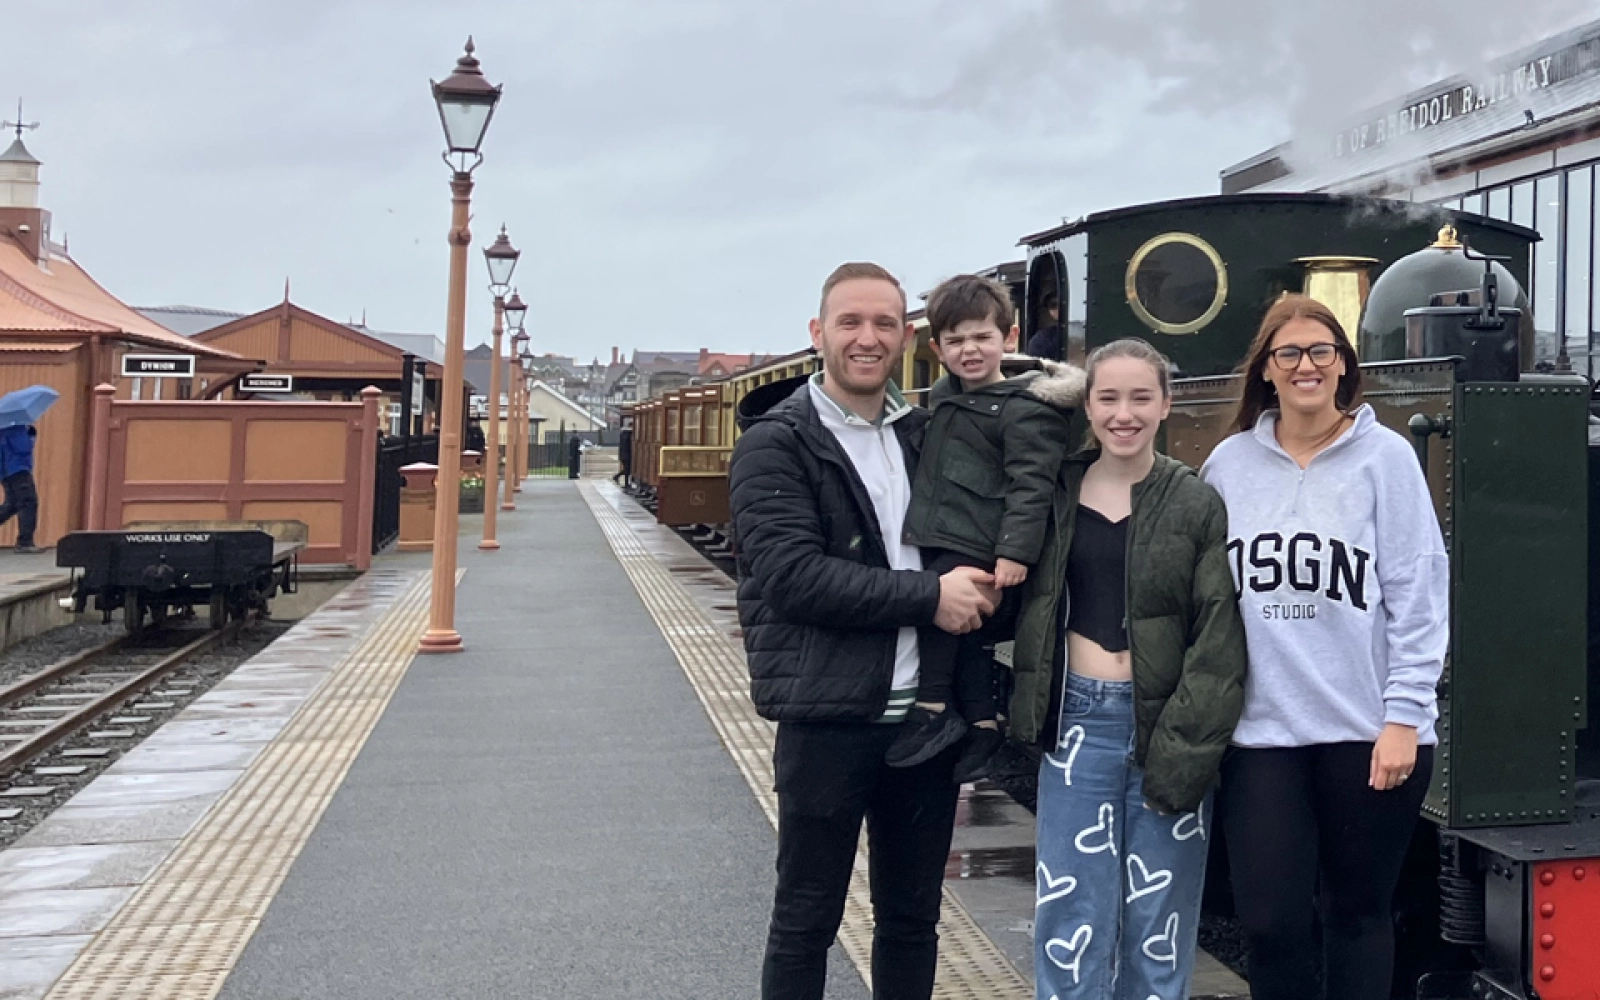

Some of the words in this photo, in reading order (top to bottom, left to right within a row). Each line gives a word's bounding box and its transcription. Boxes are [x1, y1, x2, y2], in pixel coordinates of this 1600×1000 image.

[1461, 56, 1552, 114] RAILWAY
[125, 534, 162, 543] WORKS
[164, 534, 181, 543] USE
[183, 534, 211, 543] ONLY
